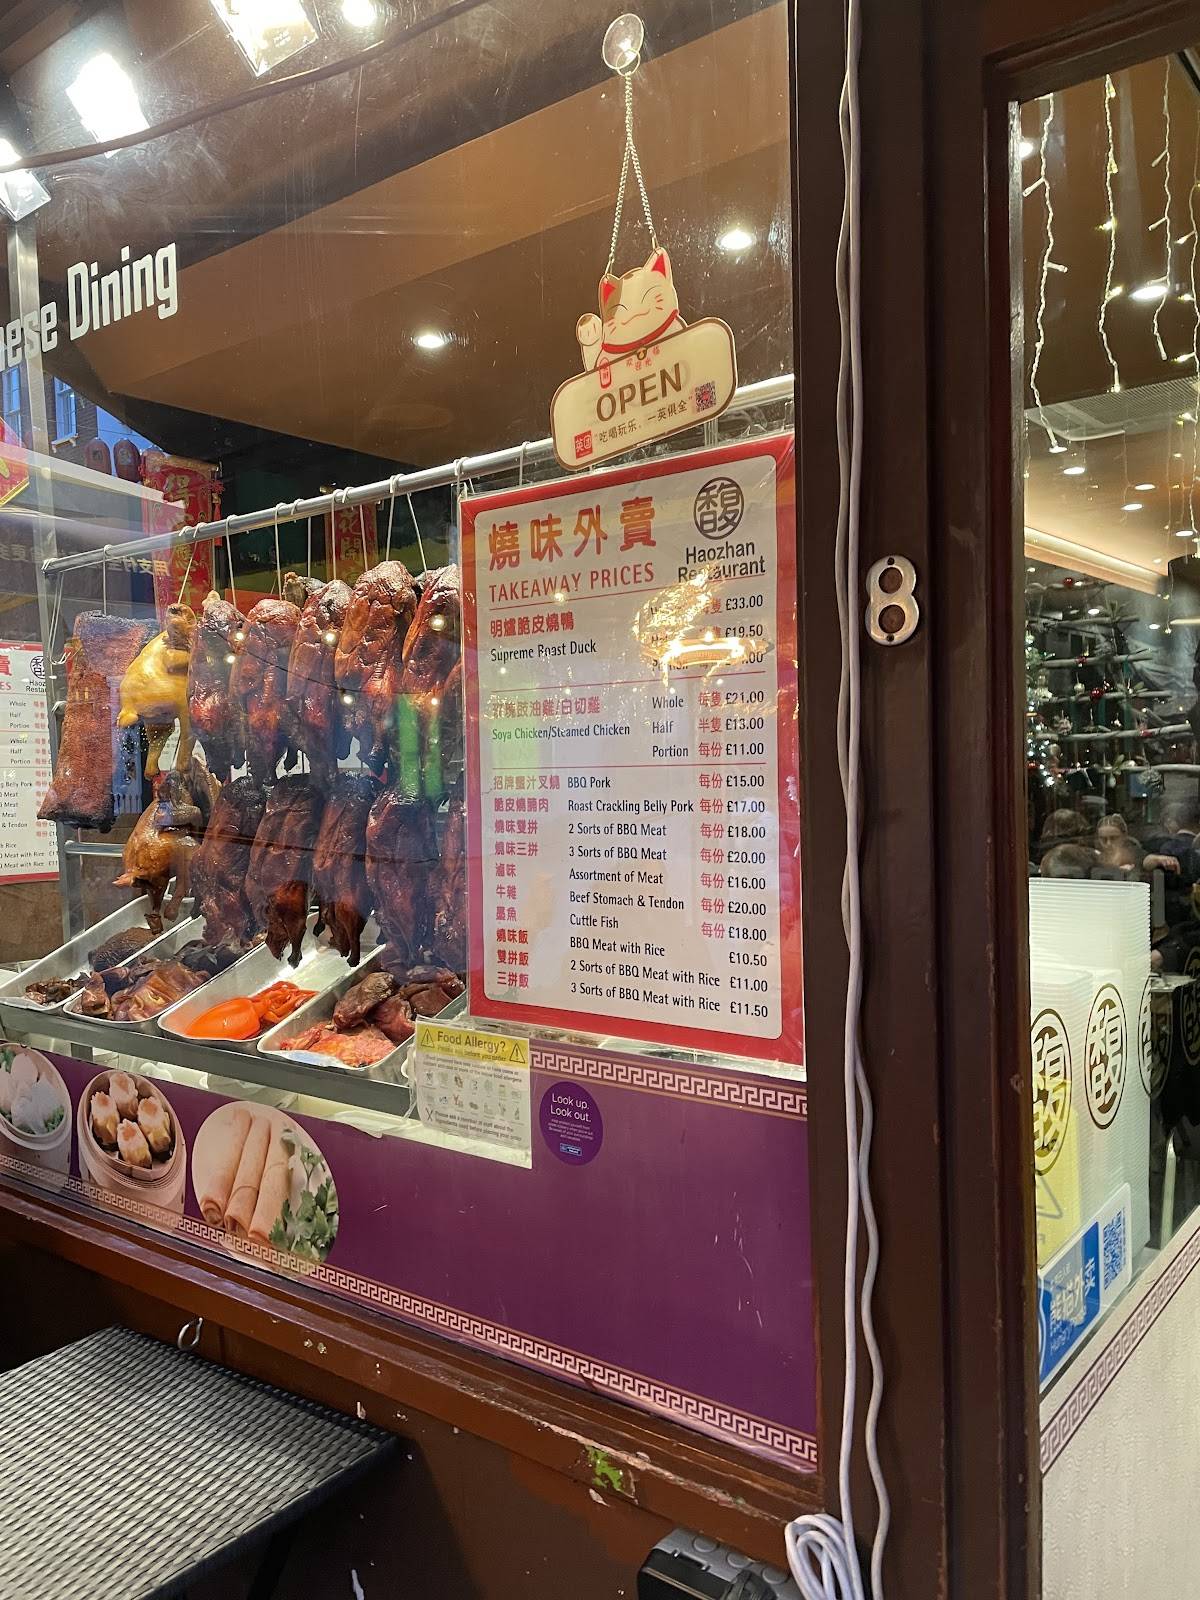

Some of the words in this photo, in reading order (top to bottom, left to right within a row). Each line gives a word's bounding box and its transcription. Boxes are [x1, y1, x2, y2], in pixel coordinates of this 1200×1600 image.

[67, 242, 178, 341] Dining
[596, 362, 682, 422] OPEN
[489, 497, 656, 570] 燒味外賣
[686, 541, 755, 565] Haozhan
[489, 573, 582, 603] TAKEAWAY
[590, 563, 654, 590] PRICES
[725, 594, 763, 611] £33.00
[865, 555, 919, 645] 8
[725, 624, 763, 638] £19.50
[491, 648, 534, 662] Supreme
[538, 643, 566, 657] Roast
[570, 639, 597, 655] Duck
[652, 696, 684, 709] Whole
[726, 691, 764, 704] £21.00
[492, 728, 511, 742] Soya
[514, 724, 590, 740] Chicken/Steamed
[593, 723, 630, 736] Chicken
[652, 721, 674, 734] Half
[698, 716, 722, 733] 半隻
[726, 717, 764, 730] £13.00
[652, 745, 689, 758] Portion
[698, 742, 722, 758] 每份
[726, 743, 764, 756] £11.00
[567, 776, 587, 789] BBQ
[590, 777, 611, 789] Pork
[699, 772, 723, 789] 每份
[726, 775, 764, 788] £15.00
[568, 800, 593, 812] Roast
[596, 799, 640, 814] Crackling
[644, 799, 667, 814] Belly
[671, 800, 694, 812] Pork
[700, 798, 723, 814] 每份
[727, 800, 765, 813] £17.00
[494, 819, 538, 834] 燒味雙拼
[568, 823, 574, 834] 2
[577, 823, 600, 835] Sorts
[603, 823, 616, 835] of
[617, 824, 637, 836] BBQ
[640, 824, 667, 836] Meat
[700, 823, 724, 839] 每份
[727, 825, 766, 838] £18.00
[495, 841, 538, 857] 燒味三拼
[569, 846, 575, 857] 3
[578, 846, 600, 858] Sorts
[604, 846, 616, 859] of
[617, 847, 637, 860] BBQ
[641, 847, 667, 860] Meat
[701, 848, 724, 864] 每份
[727, 851, 766, 864] £20.00
[569, 868, 621, 882] Assortment
[624, 871, 635, 882] of
[637, 872, 663, 884] Meat
[701, 872, 724, 889] 每份
[728, 877, 766, 890] £16.00
[569, 891, 590, 903] Beef
[593, 892, 634, 906] Stomach
[637, 895, 646, 907] &
[648, 896, 684, 910] Tendon
[701, 897, 725, 914] 每份
[728, 901, 766, 915] £20.00
[496, 906, 517, 922] 墨魚
[570, 913, 598, 927] Cuttle
[601, 916, 619, 929] Fish
[496, 928, 529, 944] 燒味飯
[701, 922, 725, 939] 每份
[728, 926, 767, 941] £18.00
[570, 936, 589, 949] BBQ
[592, 938, 617, 952] Meat
[620, 941, 641, 954] with
[645, 943, 665, 957] Rice
[497, 949, 529, 966] 雙拼飯
[729, 951, 767, 967] £10.50
[497, 971, 529, 988] 三拼飯
[570, 959, 576, 971] 2
[580, 960, 603, 974] Sorts
[605, 964, 616, 975] of
[619, 964, 640, 978] BBQ
[642, 967, 669, 981] Meat
[672, 970, 695, 984] with
[698, 972, 721, 987] Rice
[730, 976, 768, 992] £11.00
[571, 982, 577, 993] 3
[580, 983, 603, 997] Sorts
[605, 987, 616, 998] of
[619, 987, 640, 1001] BBQ
[643, 990, 669, 1005] Meat
[672, 995, 695, 1008] with
[698, 997, 721, 1012] Rice
[730, 1001, 768, 1018] £11.50
[437, 1031, 462, 1045] Food
[465, 1036, 506, 1054] Allergy?
[552, 1093, 574, 1106] Look
[575, 1099, 590, 1110] up.
[550, 1104, 572, 1118] Look
[574, 1111, 592, 1123] out.
